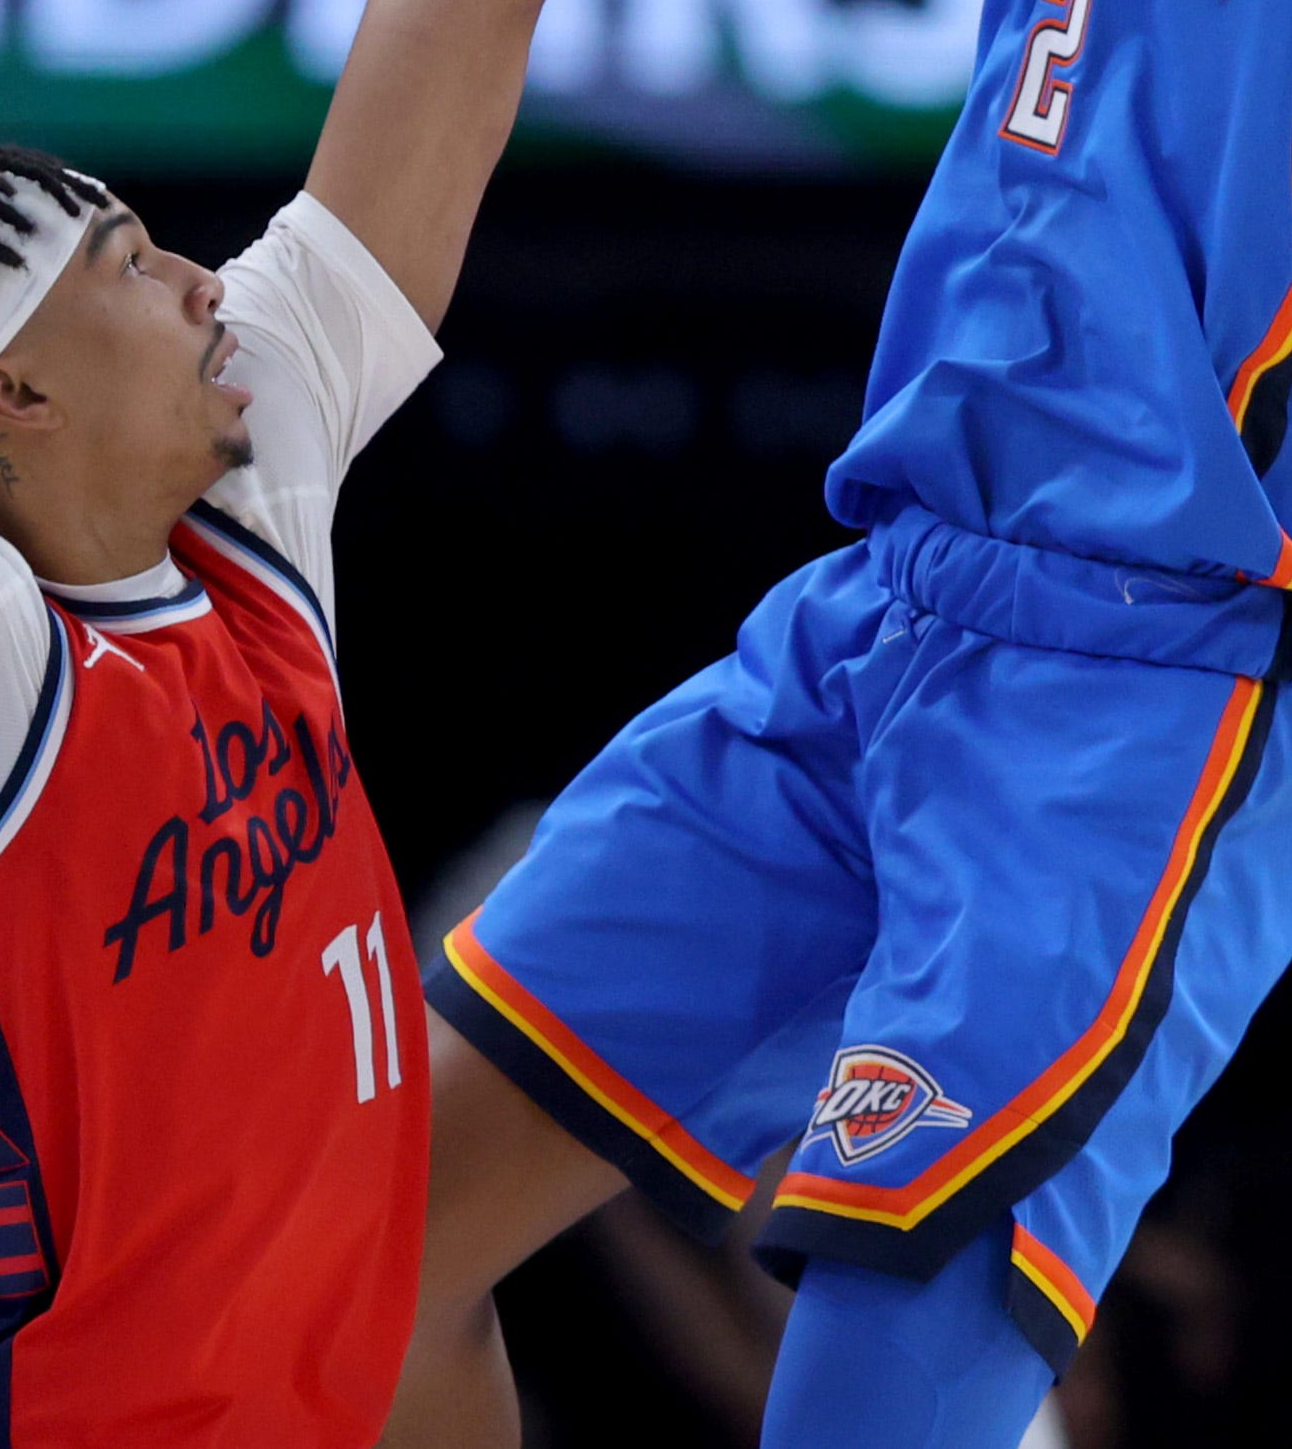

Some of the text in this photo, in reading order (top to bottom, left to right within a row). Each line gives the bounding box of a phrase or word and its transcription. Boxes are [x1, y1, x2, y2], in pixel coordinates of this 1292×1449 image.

[188, 697, 291, 824] Los
[321, 910, 402, 1104] 11
[812, 1078, 913, 1128] OKC
